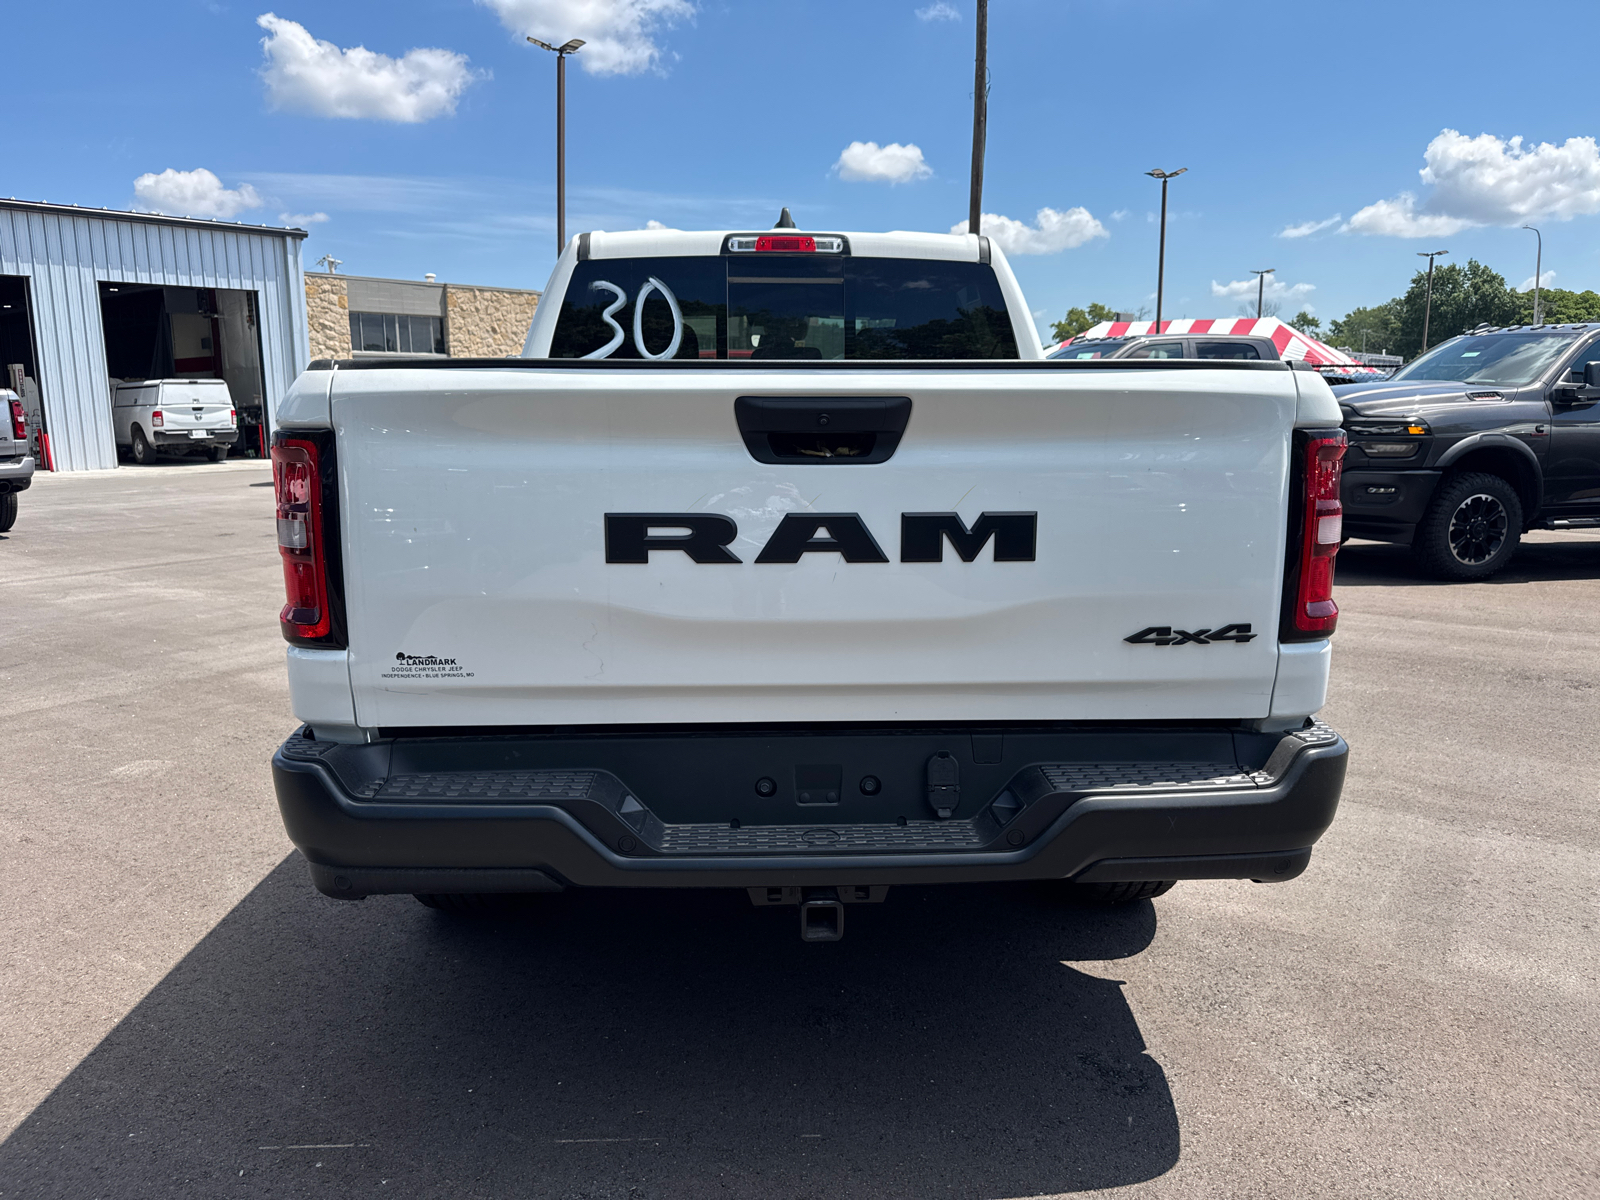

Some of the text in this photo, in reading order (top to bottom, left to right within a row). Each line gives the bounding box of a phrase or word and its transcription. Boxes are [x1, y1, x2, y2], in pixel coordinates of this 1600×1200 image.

[580, 275, 684, 360] 30
[604, 511, 1038, 564] RAM
[406, 658, 457, 666] LANDMARK
